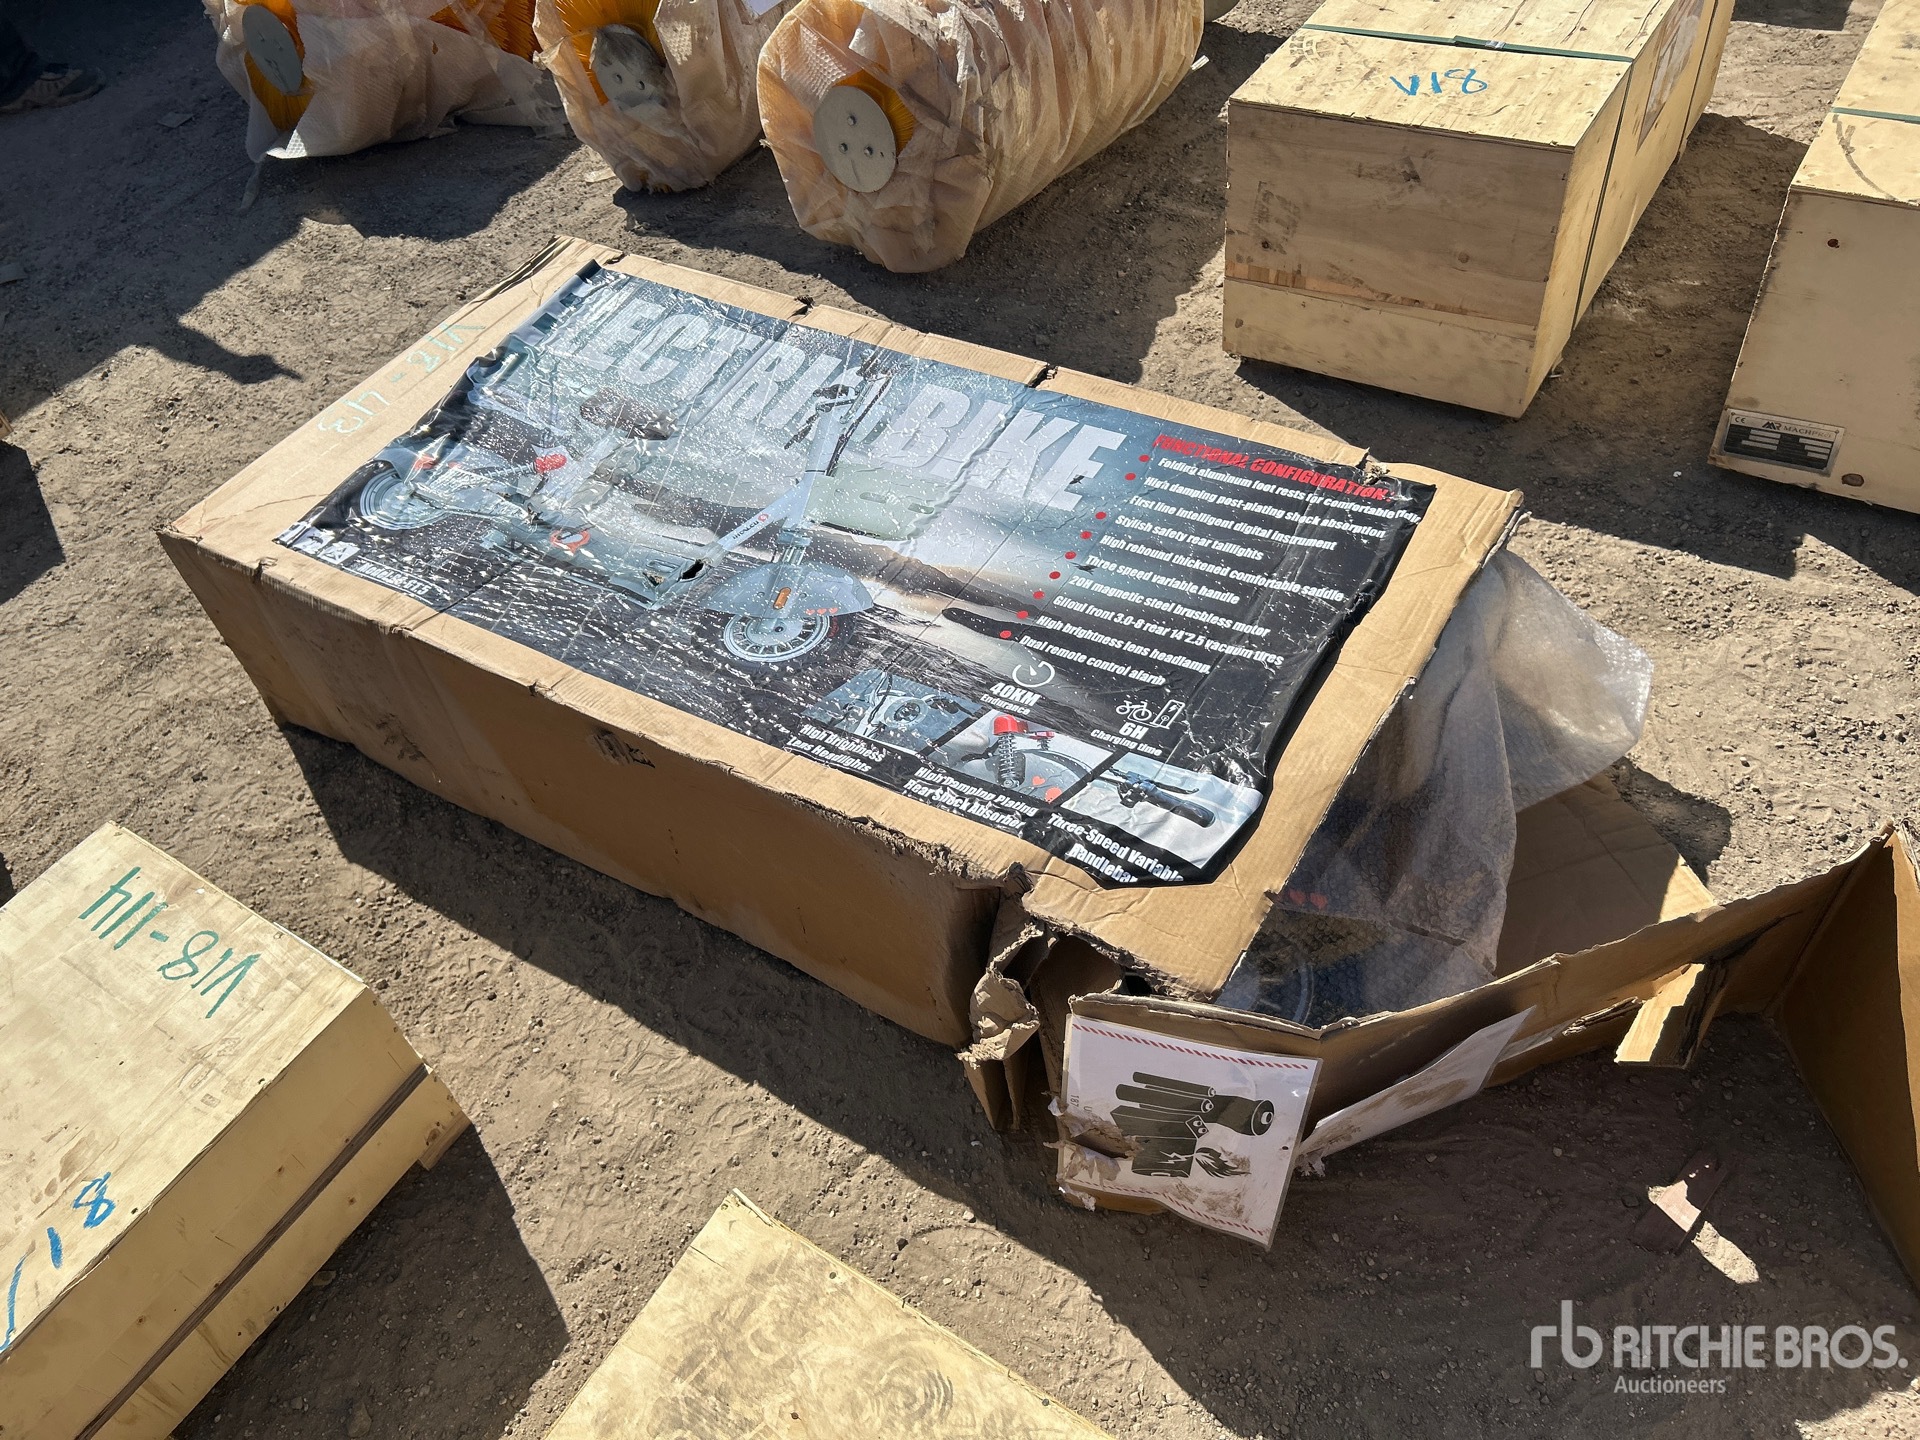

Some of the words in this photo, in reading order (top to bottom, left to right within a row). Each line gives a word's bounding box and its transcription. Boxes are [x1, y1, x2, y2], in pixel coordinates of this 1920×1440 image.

[1390, 68, 1488, 96] V18
[870, 383, 1127, 512] BIKE
[1153, 434, 1249, 468] FUNCTIONAL
[1143, 476, 1170, 491] High
[1169, 484, 1218, 504] damping
[1215, 494, 1286, 520] post-plating
[1284, 511, 1321, 526] shock
[1320, 519, 1387, 540] absorption
[1158, 457, 1197, 476] Folding
[1197, 469, 1253, 487] aluminum
[1252, 480, 1275, 493] foot
[1274, 487, 1306, 500] rests
[1305, 494, 1323, 505] for
[1323, 499, 1394, 519] comfortable
[1115, 514, 1154, 533] Stylish
[1152, 525, 1192, 543] safety
[1186, 535, 1215, 549] rear
[1211, 540, 1265, 561] taillights
[1129, 495, 1156, 510] First
[1154, 502, 1177, 516] line
[1175, 505, 1236, 531] intelligent
[1233, 521, 1274, 540] digital
[1270, 530, 1338, 551] instrument
[1085, 554, 1118, 571] Three
[1116, 563, 1154, 581] speed
[1151, 574, 1200, 594] variable
[1197, 584, 1241, 605] handle
[1100, 534, 1127, 550] High
[1125, 541, 1175, 562] rebound
[1172, 553, 1232, 577] thickened
[1228, 569, 1301, 594] comfortable
[1299, 584, 1346, 602] saddle
[1068, 575, 1095, 589] 20H
[1091, 581, 1145, 604] magnetic
[1143, 596, 1176, 613] steel
[1231, 619, 1272, 637] motor
[1019, 635, 1048, 651] Dual
[1045, 643, 1087, 664] remote
[1086, 657, 1132, 677] control
[1036, 615, 1064, 631] High
[1062, 623, 1125, 649] brightness
[1122, 641, 1151, 657] lens
[1085, 604, 1116, 621] front
[1113, 611, 1145, 629] 3.0-8
[1142, 621, 1171, 637] rear
[1203, 639, 1254, 660] vacuum
[1251, 651, 1285, 666] tires
[980, 693, 1031, 716] Endurance
[989, 682, 1041, 707] 40KM
[786, 735, 815, 751] Lens
[811, 744, 872, 772] Headlights
[800, 723, 828, 741] High
[824, 731, 886, 762] Brightness
[1119, 721, 1150, 740] 6H
[1136, 742, 1163, 757] time
[903, 779, 936, 798] Rear
[931, 786, 972, 811] Shock
[968, 801, 1026, 829] Absorber
[914, 766, 943, 784] High
[941, 776, 997, 802] Damping
[994, 794, 1040, 817] Plating
[1049, 812, 1131, 860] Three-Speed
[78, 866, 261, 1019] V18-114
